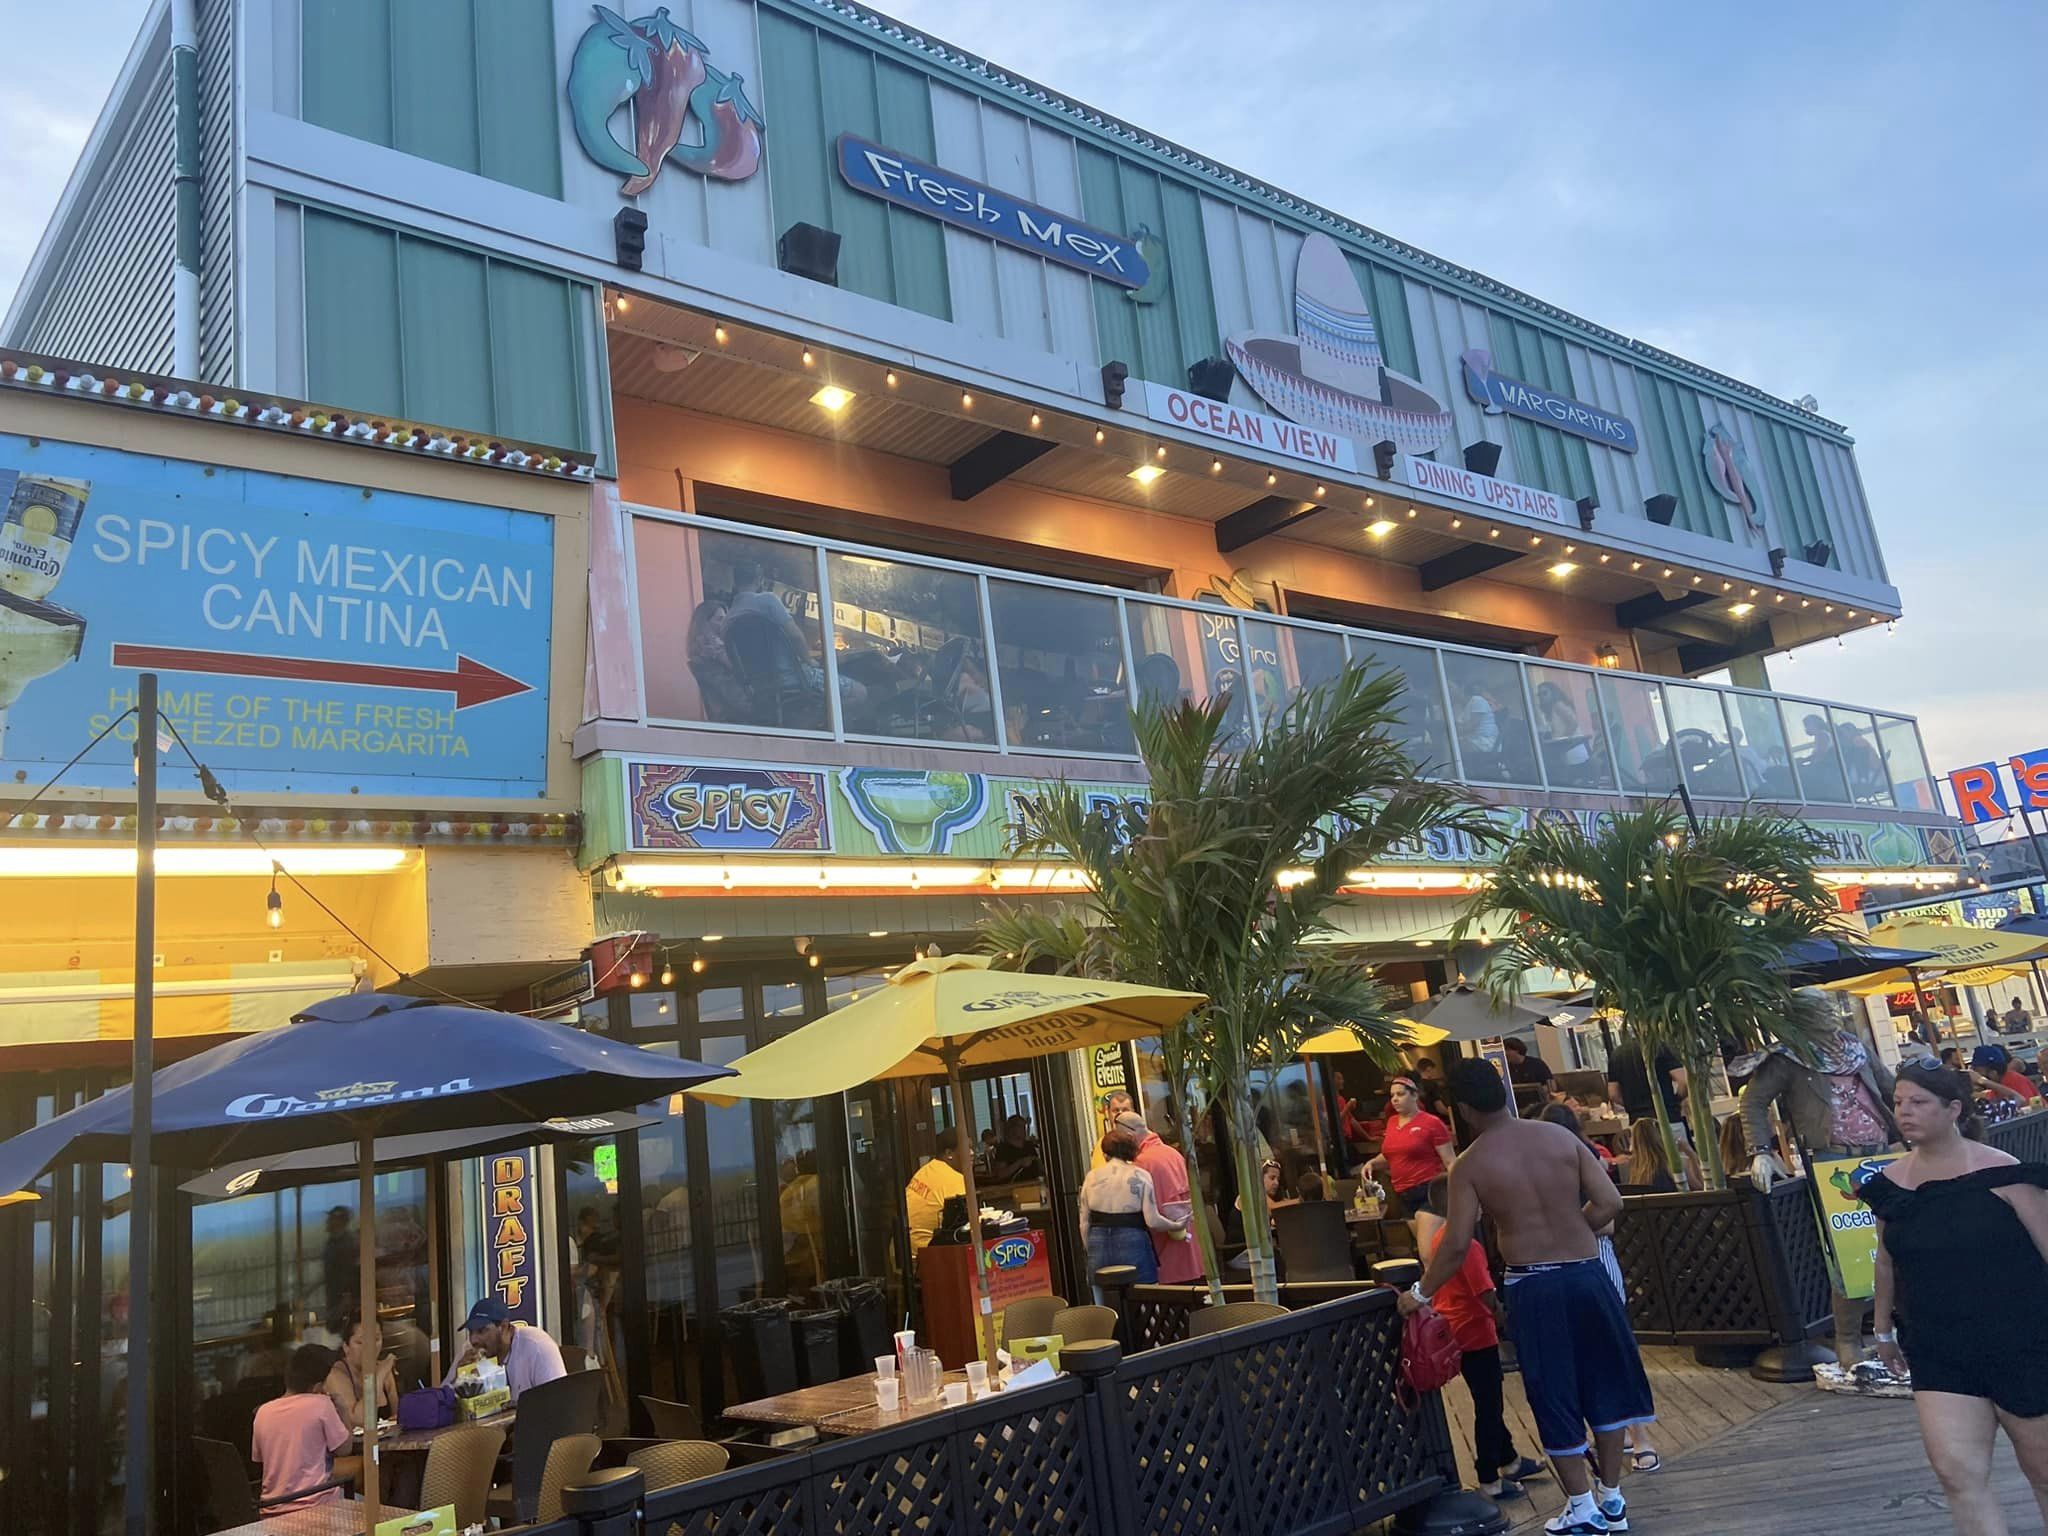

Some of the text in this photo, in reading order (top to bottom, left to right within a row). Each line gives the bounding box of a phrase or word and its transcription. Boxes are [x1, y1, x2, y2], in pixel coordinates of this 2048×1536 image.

[863, 150, 1125, 272] Fresh Mex
[1167, 393, 1337, 463] OCEAN VIEW
[1499, 382, 1626, 440] MARGARITAS
[1414, 460, 1559, 519] DINING UPSTAIRS
[92, 514, 534, 610] SPICY MEXICAN
[202, 584, 450, 650] CANTINA
[88, 714, 470, 757] SQEEZED MARGARITA
[108, 687, 455, 731] HME OF THE FRESH
[1975, 907, 2008, 919] BUD
[225, 1078, 476, 1117] Corona
[492, 1156, 529, 1309] DRAFT
